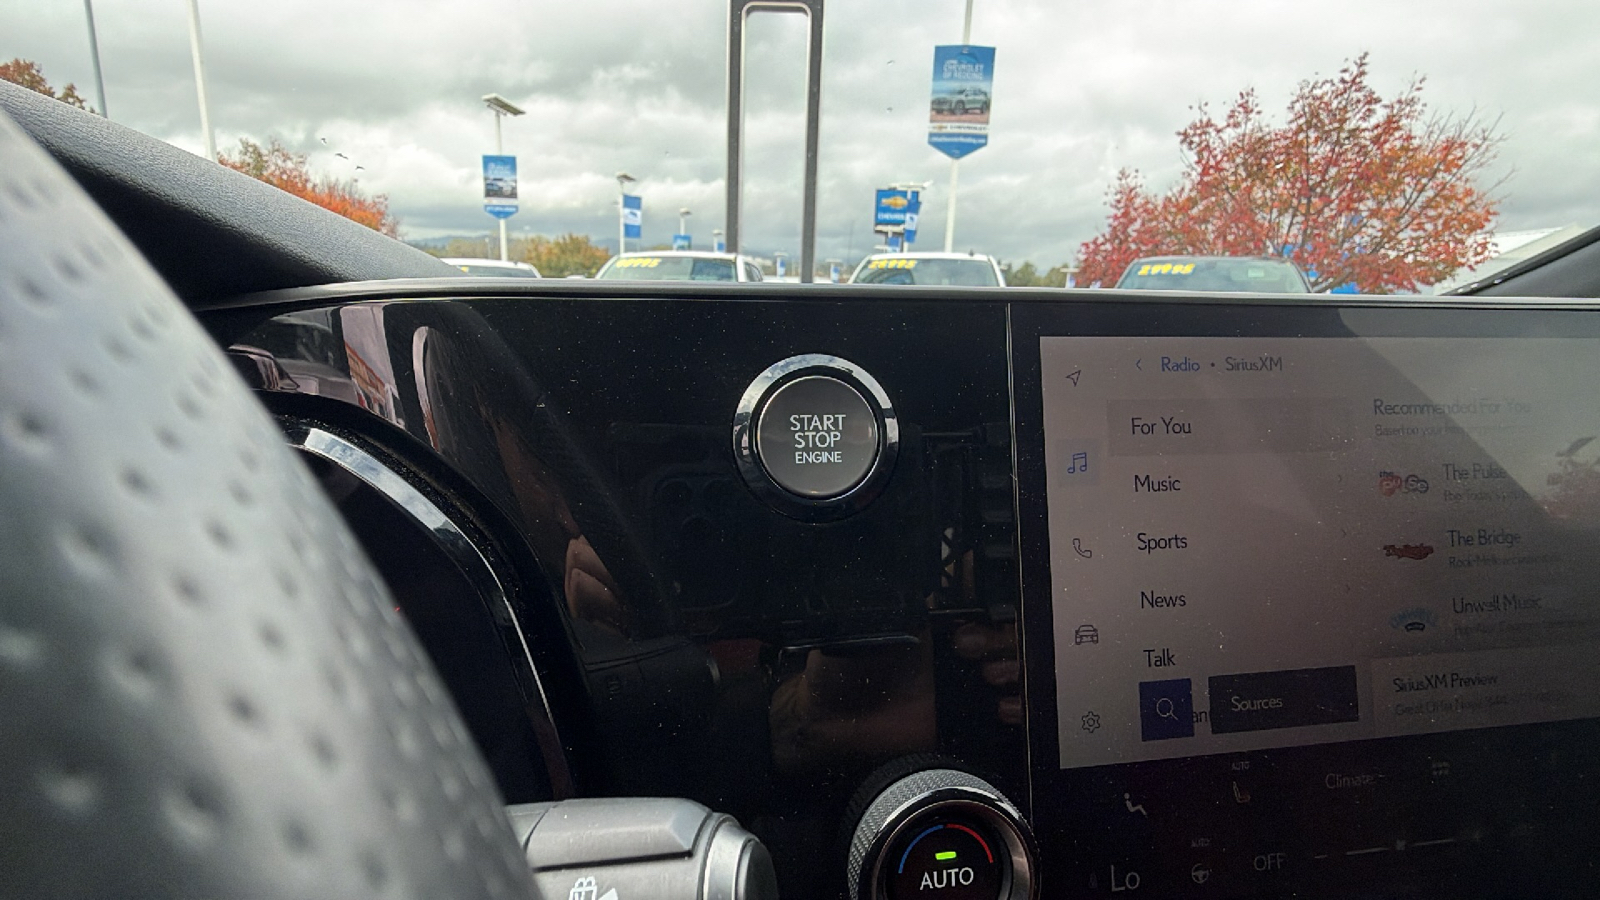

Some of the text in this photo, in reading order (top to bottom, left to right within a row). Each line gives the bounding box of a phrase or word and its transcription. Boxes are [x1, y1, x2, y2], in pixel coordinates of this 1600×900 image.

[1161, 356, 1283, 371] Radio SiriusXM
[1373, 398, 1477, 416] Recommended
[790, 414, 847, 431] START
[1131, 416, 1192, 435] For You
[794, 431, 841, 449] STOP
[795, 451, 842, 464] ENGINE
[1442, 462, 1506, 480] The Pulse
[1134, 474, 1181, 492] Music
[1137, 532, 1188, 555] Sports
[1447, 528, 1521, 548] The Bridge
[1141, 590, 1186, 609] News
[1143, 648, 1176, 667] Talk
[1393, 672, 1499, 692] SiriusXM Preview
[1231, 696, 1284, 711] Sources
[1325, 773, 1376, 790] Climate
[1254, 852, 1286, 871] OFF
[919, 867, 974, 890] AUTO
[1110, 865, 1140, 892] Lo
